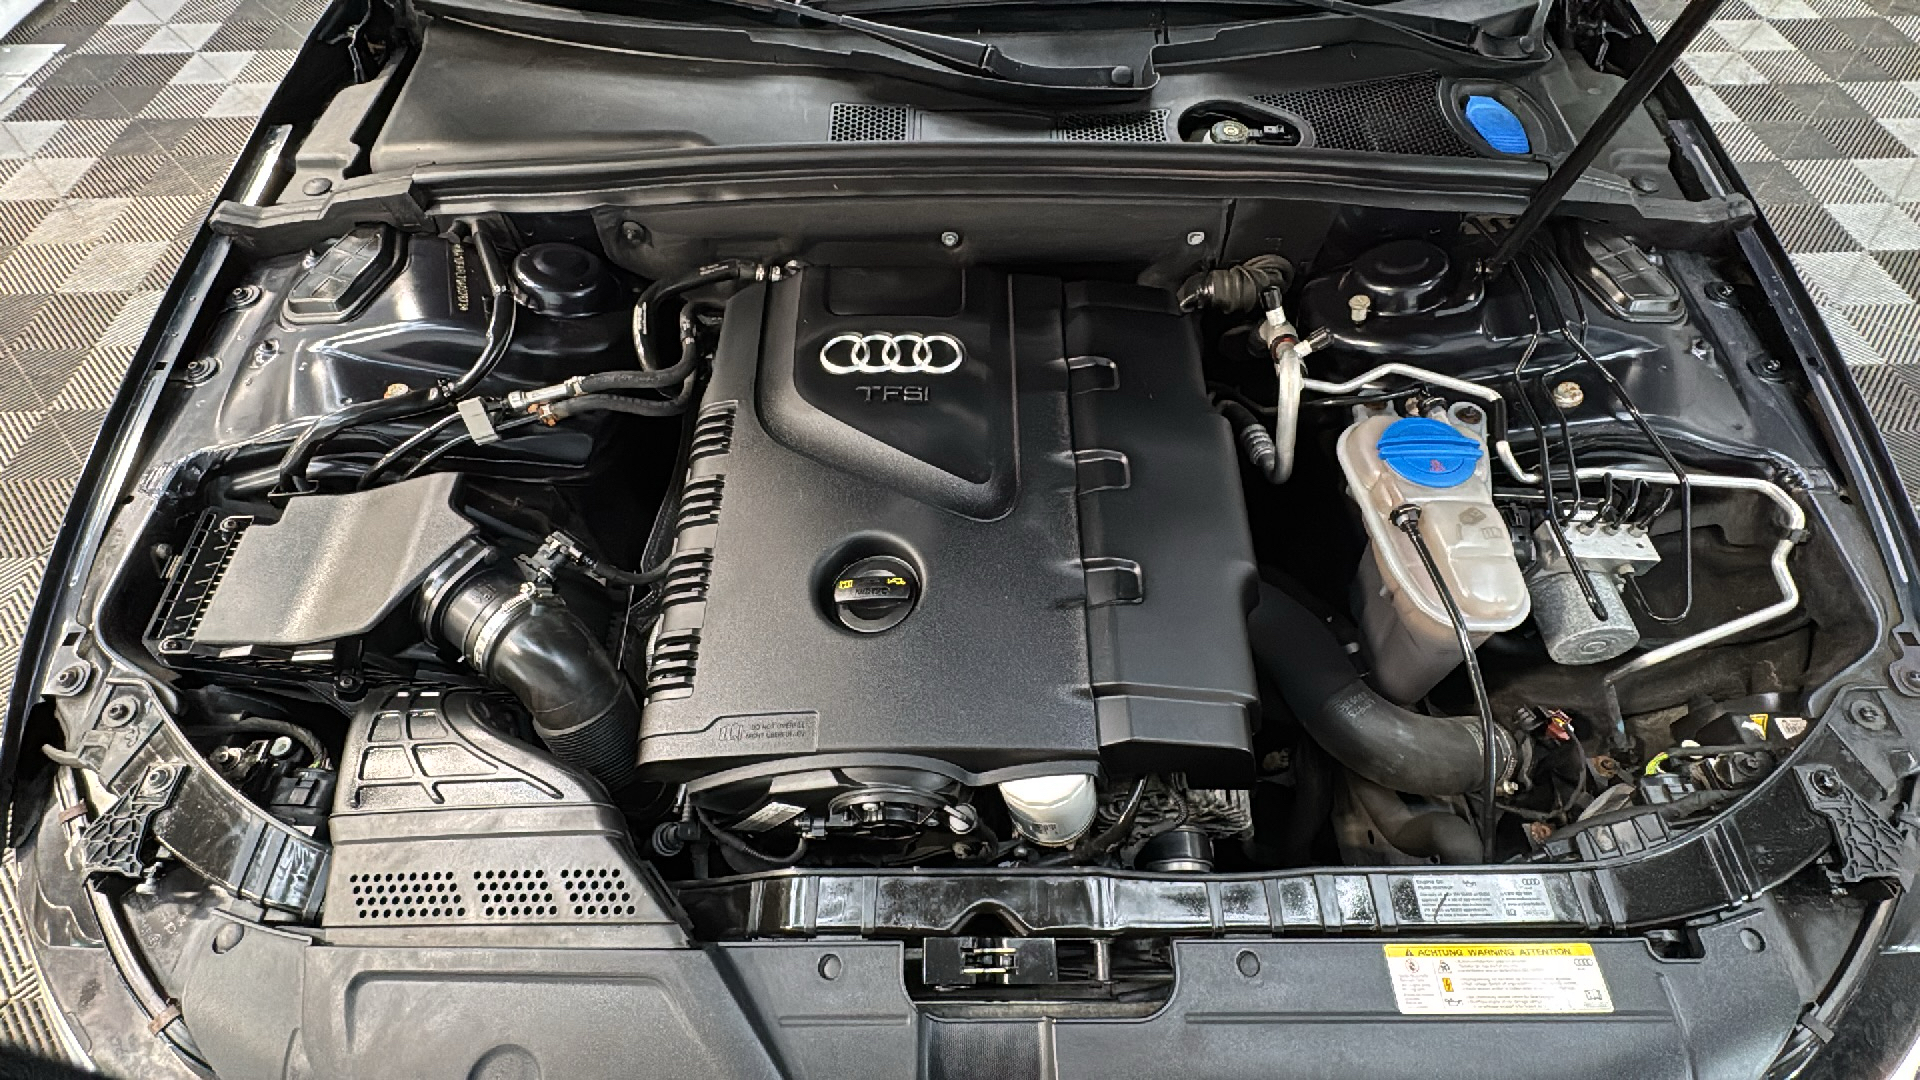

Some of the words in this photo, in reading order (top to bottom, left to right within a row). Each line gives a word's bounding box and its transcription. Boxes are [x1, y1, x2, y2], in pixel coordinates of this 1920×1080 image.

[855, 385, 929, 401] TFSI
[1418, 949, 1463, 957] ACHTUNG
[1467, 949, 1515, 957] WARNING
[1519, 948, 1572, 956] ATTENTION
